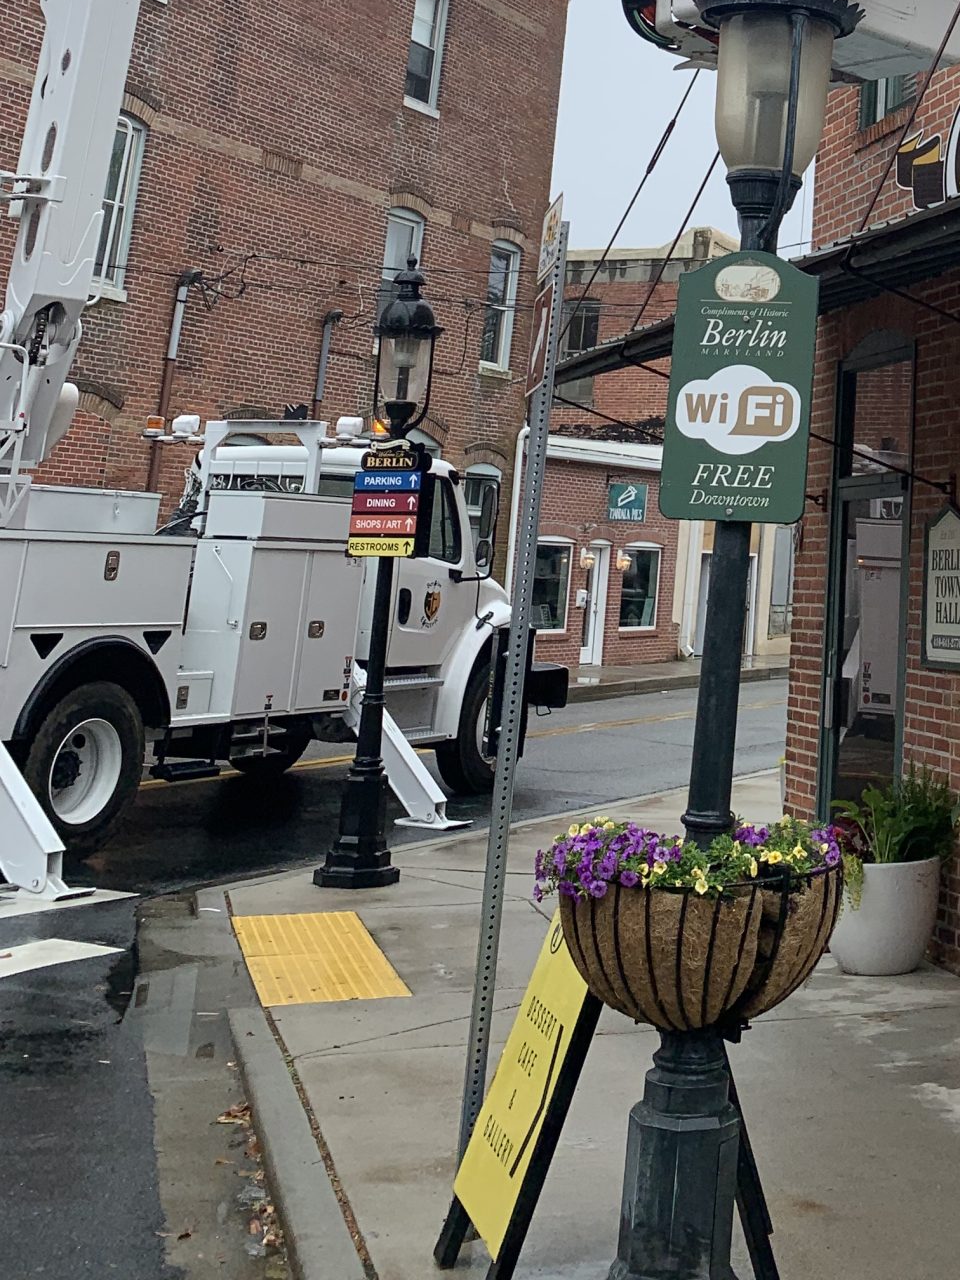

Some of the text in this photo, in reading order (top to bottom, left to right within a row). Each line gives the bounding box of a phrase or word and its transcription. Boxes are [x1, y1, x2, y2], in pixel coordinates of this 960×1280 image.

[700, 306, 789, 318] Compliments of Historic
[700, 318, 787, 348] Berlin
[700, 348, 785, 357] MARYLAND
[366, 456, 413, 467] BERLIN
[364, 476, 402, 486] PARKING
[691, 463, 775, 489] FREE
[366, 499, 396, 507] DINING
[689, 488, 770, 507] Downtown
[356, 520, 381, 529] SHOPS
[386, 520, 402, 528] ART
[349, 542, 399, 551] RESTROOMS
[935, 601, 960, 625] HALL
[527, 995, 558, 1041] DESSERT
[517, 1041, 538, 1078] CAFE
[483, 1114, 514, 1168] GALLERY
